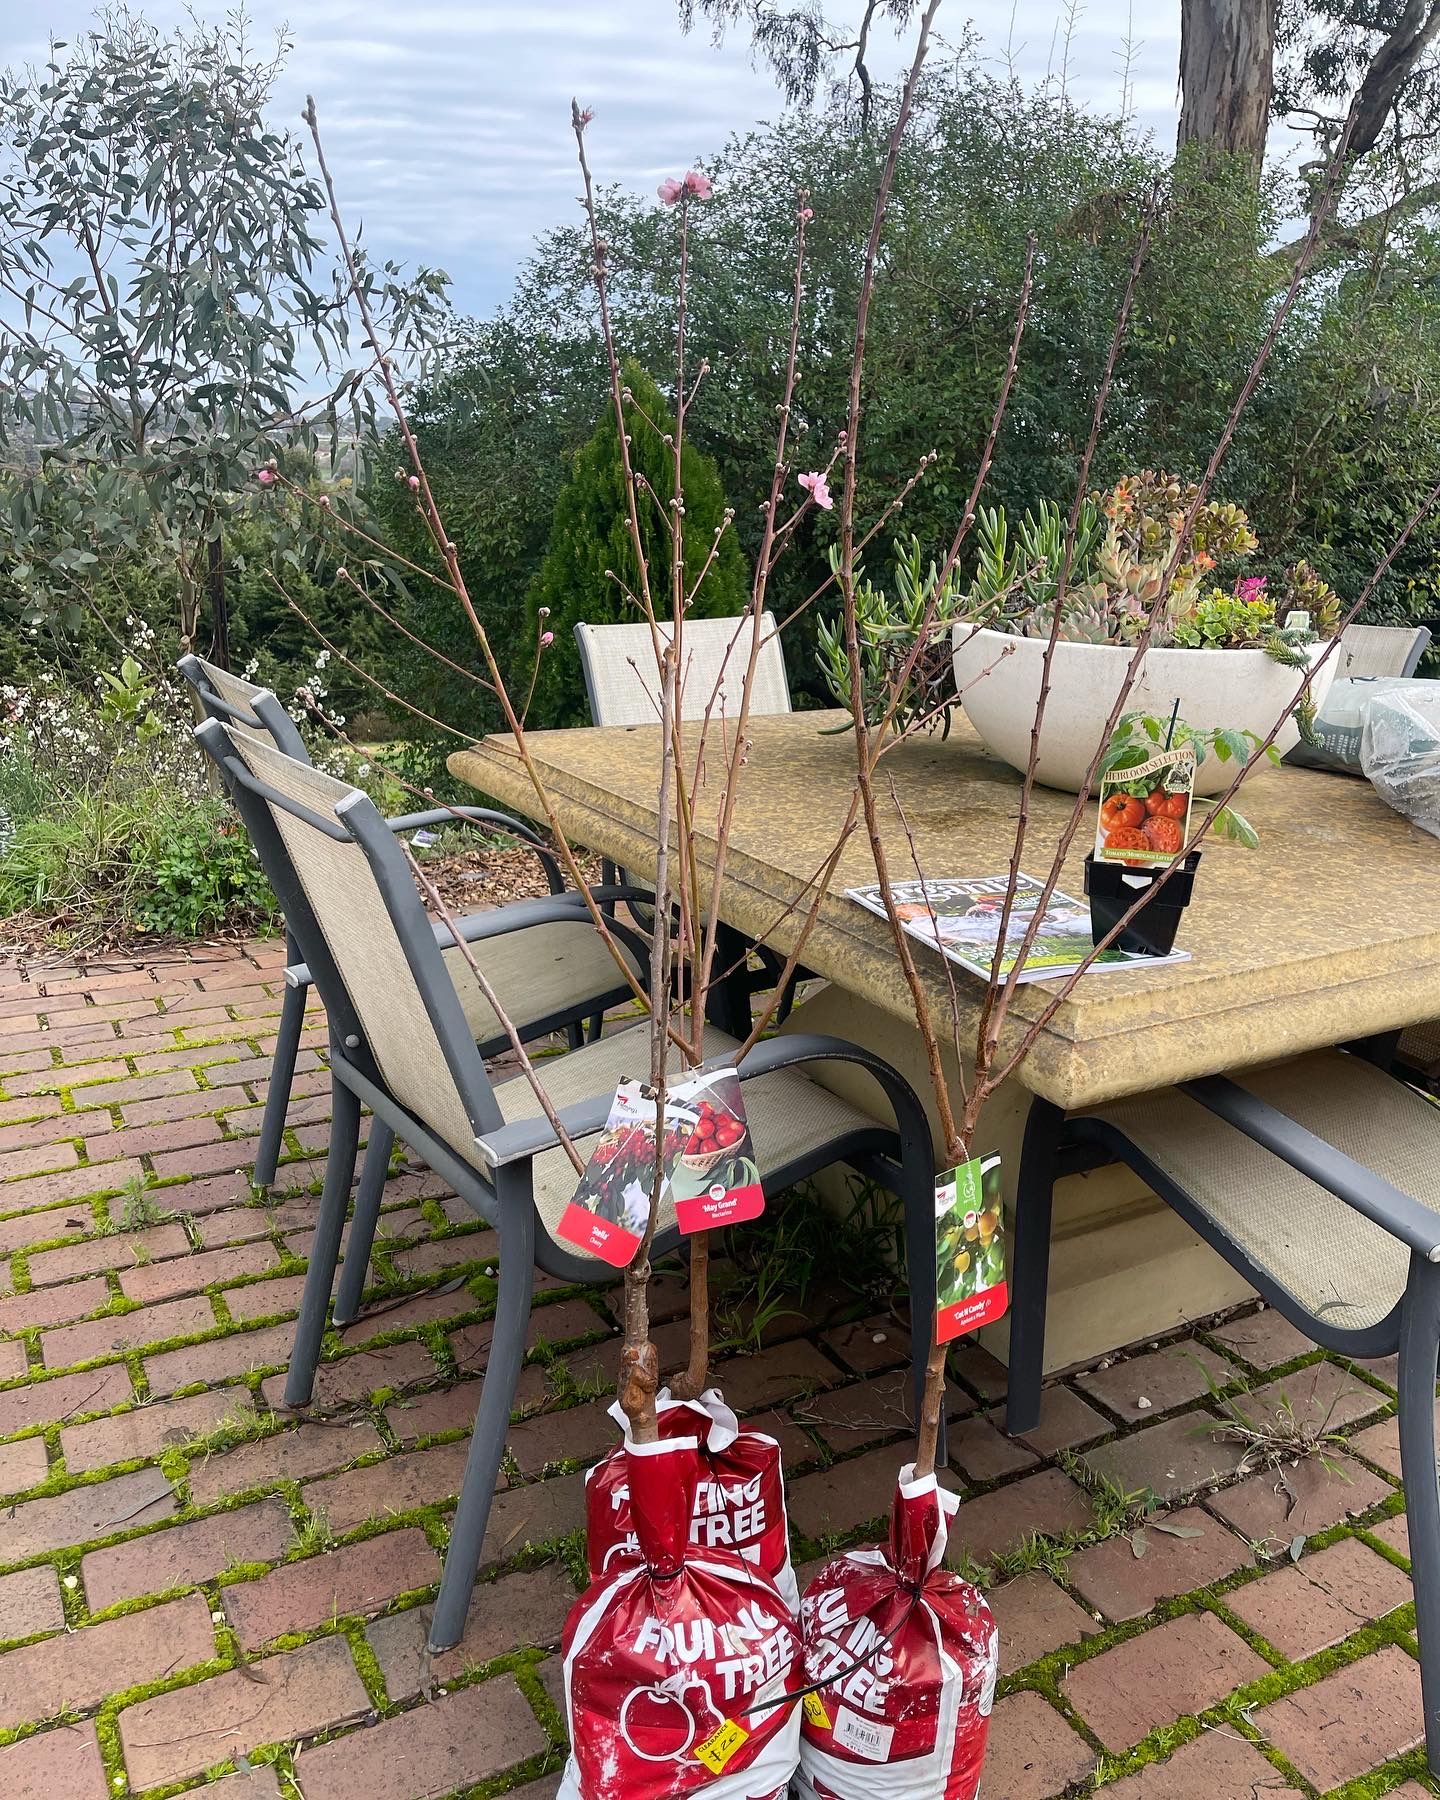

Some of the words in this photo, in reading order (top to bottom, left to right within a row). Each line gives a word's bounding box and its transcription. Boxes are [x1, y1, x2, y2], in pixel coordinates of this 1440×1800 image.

[1105, 765, 1150, 781] HEIRLOOM
[1149, 750, 1195, 769] SELECTION
[689, 1499, 766, 1547] TREE
[716, 1625, 794, 1700] TREE
[805, 1639, 890, 1716] TREE
[698, 1723, 729, 1753] CLEARANCE
